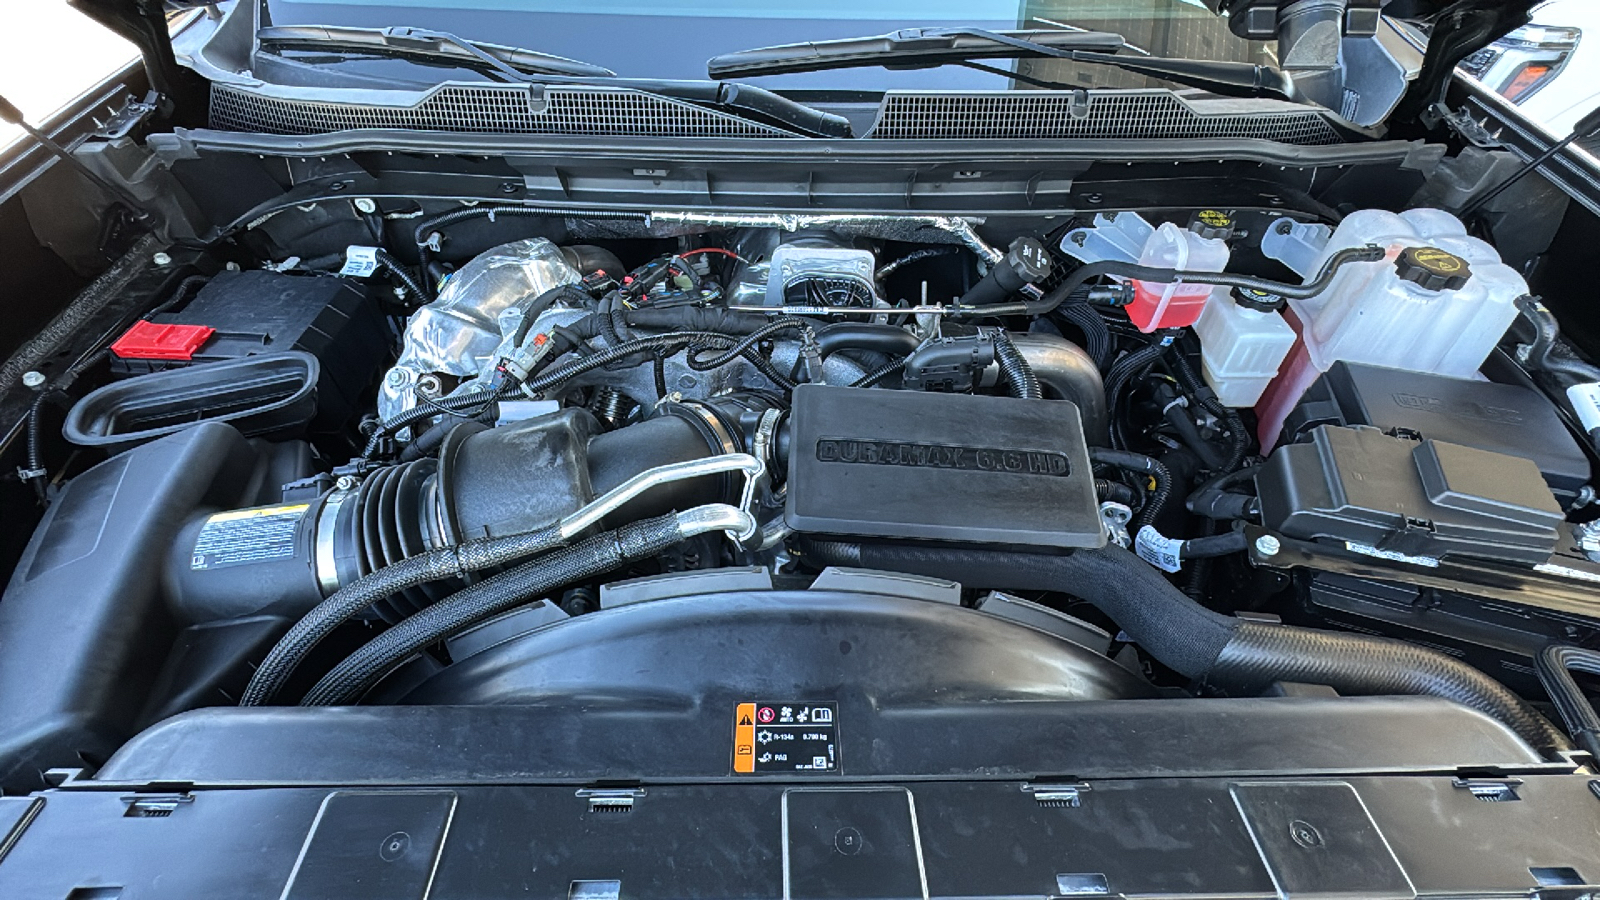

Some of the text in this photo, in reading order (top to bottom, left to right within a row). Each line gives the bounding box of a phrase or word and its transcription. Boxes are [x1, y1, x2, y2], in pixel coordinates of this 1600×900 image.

[818, 441, 1070, 474] DURAMAX 6.6 HD
